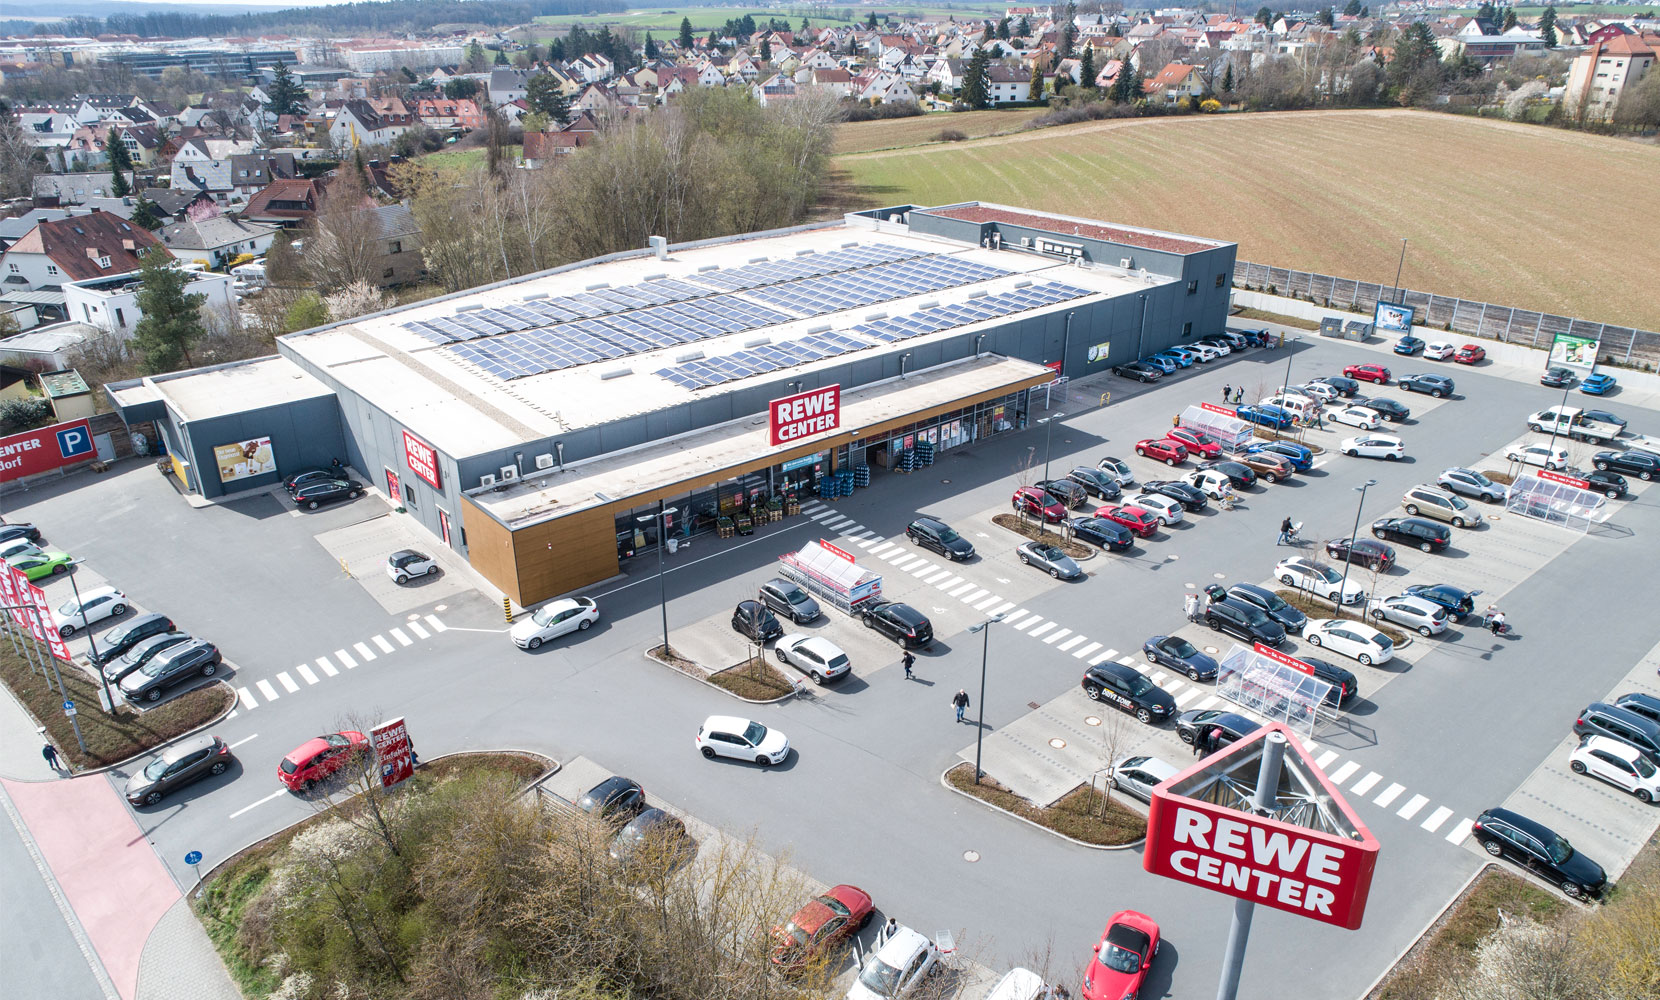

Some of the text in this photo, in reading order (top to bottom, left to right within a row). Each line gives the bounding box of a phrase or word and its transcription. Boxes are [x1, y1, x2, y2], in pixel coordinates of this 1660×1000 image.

[778, 391, 835, 424] REWE
[64, 431, 82, 453] P
[778, 413, 835, 441] CENTER
[405, 434, 434, 469] REWE
[409, 454, 436, 484] CENTER
[32, 589, 66, 658] REWE
[375, 725, 404, 742] REWE
[377, 733, 407, 749] CENTER
[383, 764, 392, 775] P
[1173, 807, 1345, 885] REWE
[1170, 850, 1335, 916] CENTER
